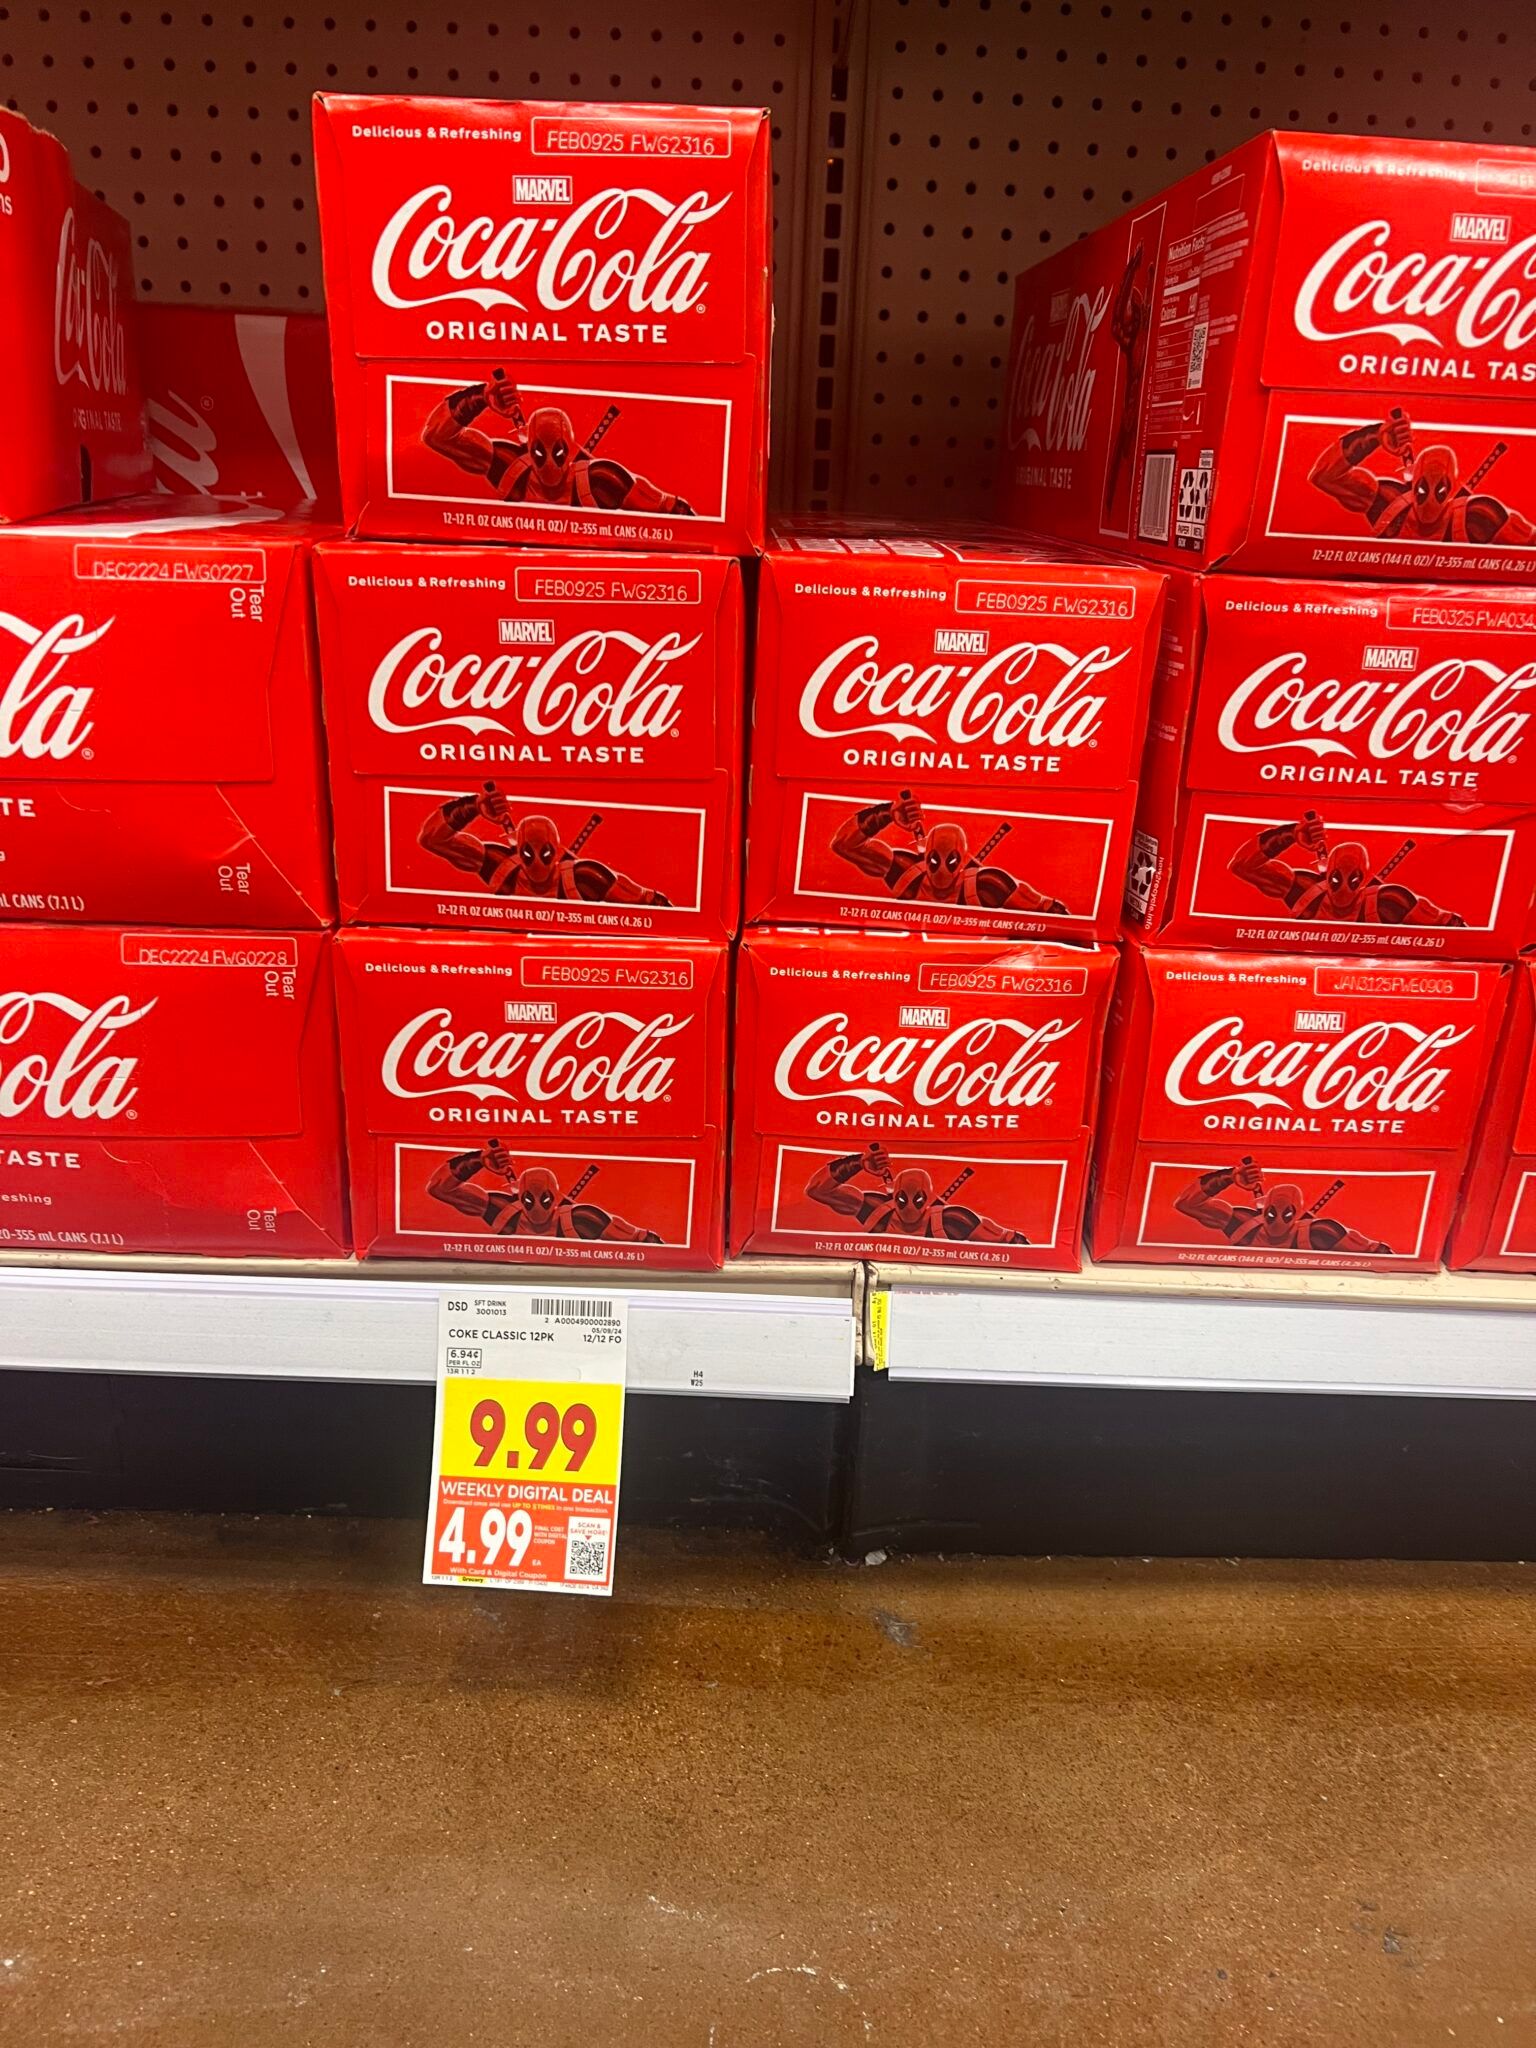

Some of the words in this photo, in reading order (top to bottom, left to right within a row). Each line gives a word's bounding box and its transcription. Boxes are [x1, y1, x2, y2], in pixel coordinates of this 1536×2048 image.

[351, 125, 422, 138] Delicious
[426, 126, 436, 138] &
[439, 127, 521, 142] Refreshing
[547, 131, 623, 151] FEB0925
[630, 133, 714, 155] FWG2316
[1302, 159, 1371, 173] Delicious
[514, 177, 571, 203] MARVEL
[1452, 216, 1506, 240] MARVEL
[1294, 220, 1536, 350] Coca-Co
[426, 320, 567, 341] ORIGINAL
[577, 323, 667, 343] TASTE
[1339, 354, 1475, 378] ORIGINAL
[1488, 362, 1536, 380] TAS
[443, 511, 464, 525] 12-12
[466, 513, 476, 526] FL
[477, 514, 489, 527] OZ
[490, 515, 513, 528] CANS
[515, 516, 535, 530] (144
[536, 518, 546, 531] FL
[547, 519, 568, 533] OZ)/
[570, 521, 597, 535] 12-355
[599, 524, 612, 536] mL
[614, 525, 636, 538] CANS
[638, 526, 662, 540] (4.26
[663, 528, 673, 541] L)
[94, 562, 169, 580] DEC2224
[173, 564, 253, 581] FWG0227
[348, 575, 413, 587] Delicious
[417, 576, 427, 587] &
[429, 576, 505, 590] Refreshing
[534, 579, 605, 597] FEB0925
[611, 582, 687, 601] FWG2316
[794, 583, 857, 595] Delicious
[861, 586, 870, 596] &
[873, 586, 946, 601] Refreshing
[230, 588, 246, 619] Out
[249, 586, 264, 622] Tear
[976, 592, 1047, 611] FEB0925
[1053, 596, 1128, 616] FWG2316
[1225, 600, 1288, 612] Delicious
[1293, 603, 1302, 613] &
[1304, 603, 1378, 618] Refreshing
[1476, 610, 1536, 629] FWA034
[501, 621, 553, 643] MARVEL
[936, 632, 986, 653] MARVEL
[1365, 648, 1415, 669] MARVEL
[419, 743, 551, 762] ORIGINAL
[560, 745, 644, 763] TASTE
[843, 748, 969, 769] ORIGINAL
[980, 754, 1060, 772] TASTE
[1260, 764, 1387, 784] ORIGINAL
[1398, 769, 1479, 787] TASTE
[218, 866, 233, 891] Out
[236, 863, 250, 894] Tear
[12, 895, 45, 909] CANS
[139, 949, 209, 965] DEC2224
[365, 962, 426, 973] Delicious
[430, 964, 439, 973] &
[441, 964, 512, 976] Refreshing
[542, 966, 610, 983] FEB0925
[615, 968, 688, 985] FWG2316
[770, 966, 828, 978] Delicious
[831, 969, 840, 979] &
[842, 970, 910, 982] Refreshing
[1166, 971, 1224, 981] Delicious
[1227, 972, 1236, 982] &
[1238, 973, 1307, 986] Refreshing
[265, 971, 279, 997] Out
[282, 968, 296, 999] Tear
[930, 972, 996, 989] FEB0925
[1002, 975, 1072, 993] FWG2316
[507, 1003, 555, 1022] MARVEL
[901, 1008, 948, 1026] MARVEL
[1296, 1012, 1343, 1031] MARVEL
[429, 1107, 552, 1123] ORIGINAL
[560, 1109, 638, 1124] TASTE
[816, 1110, 934, 1128] ORIGINAL
[944, 1114, 1019, 1128] TASTE
[1203, 1114, 1321, 1132] ORIGINAL
[1331, 1118, 1405, 1133] TASTE
[0, 1151, 81, 1168] ASTE
[264, 1208, 277, 1232] Tear
[38, 1232, 56, 1241] mL
[58, 1232, 88, 1243] CANS
[448, 1301, 468, 1311] DSD
[449, 1329, 478, 1339] COKE
[482, 1330, 526, 1340] CLASSIC
[530, 1332, 554, 1341] 12PK
[583, 1334, 606, 1343] 12/12
[470, 1399, 597, 1472] 9.99
[441, 1481, 504, 1497] WEEKLY
[508, 1485, 568, 1501] DIGITAL
[572, 1488, 613, 1504] DEAL
[438, 1507, 532, 1566] 4.99
[494, 1570, 518, 1578] Digital
[519, 1571, 547, 1579] Coupon
